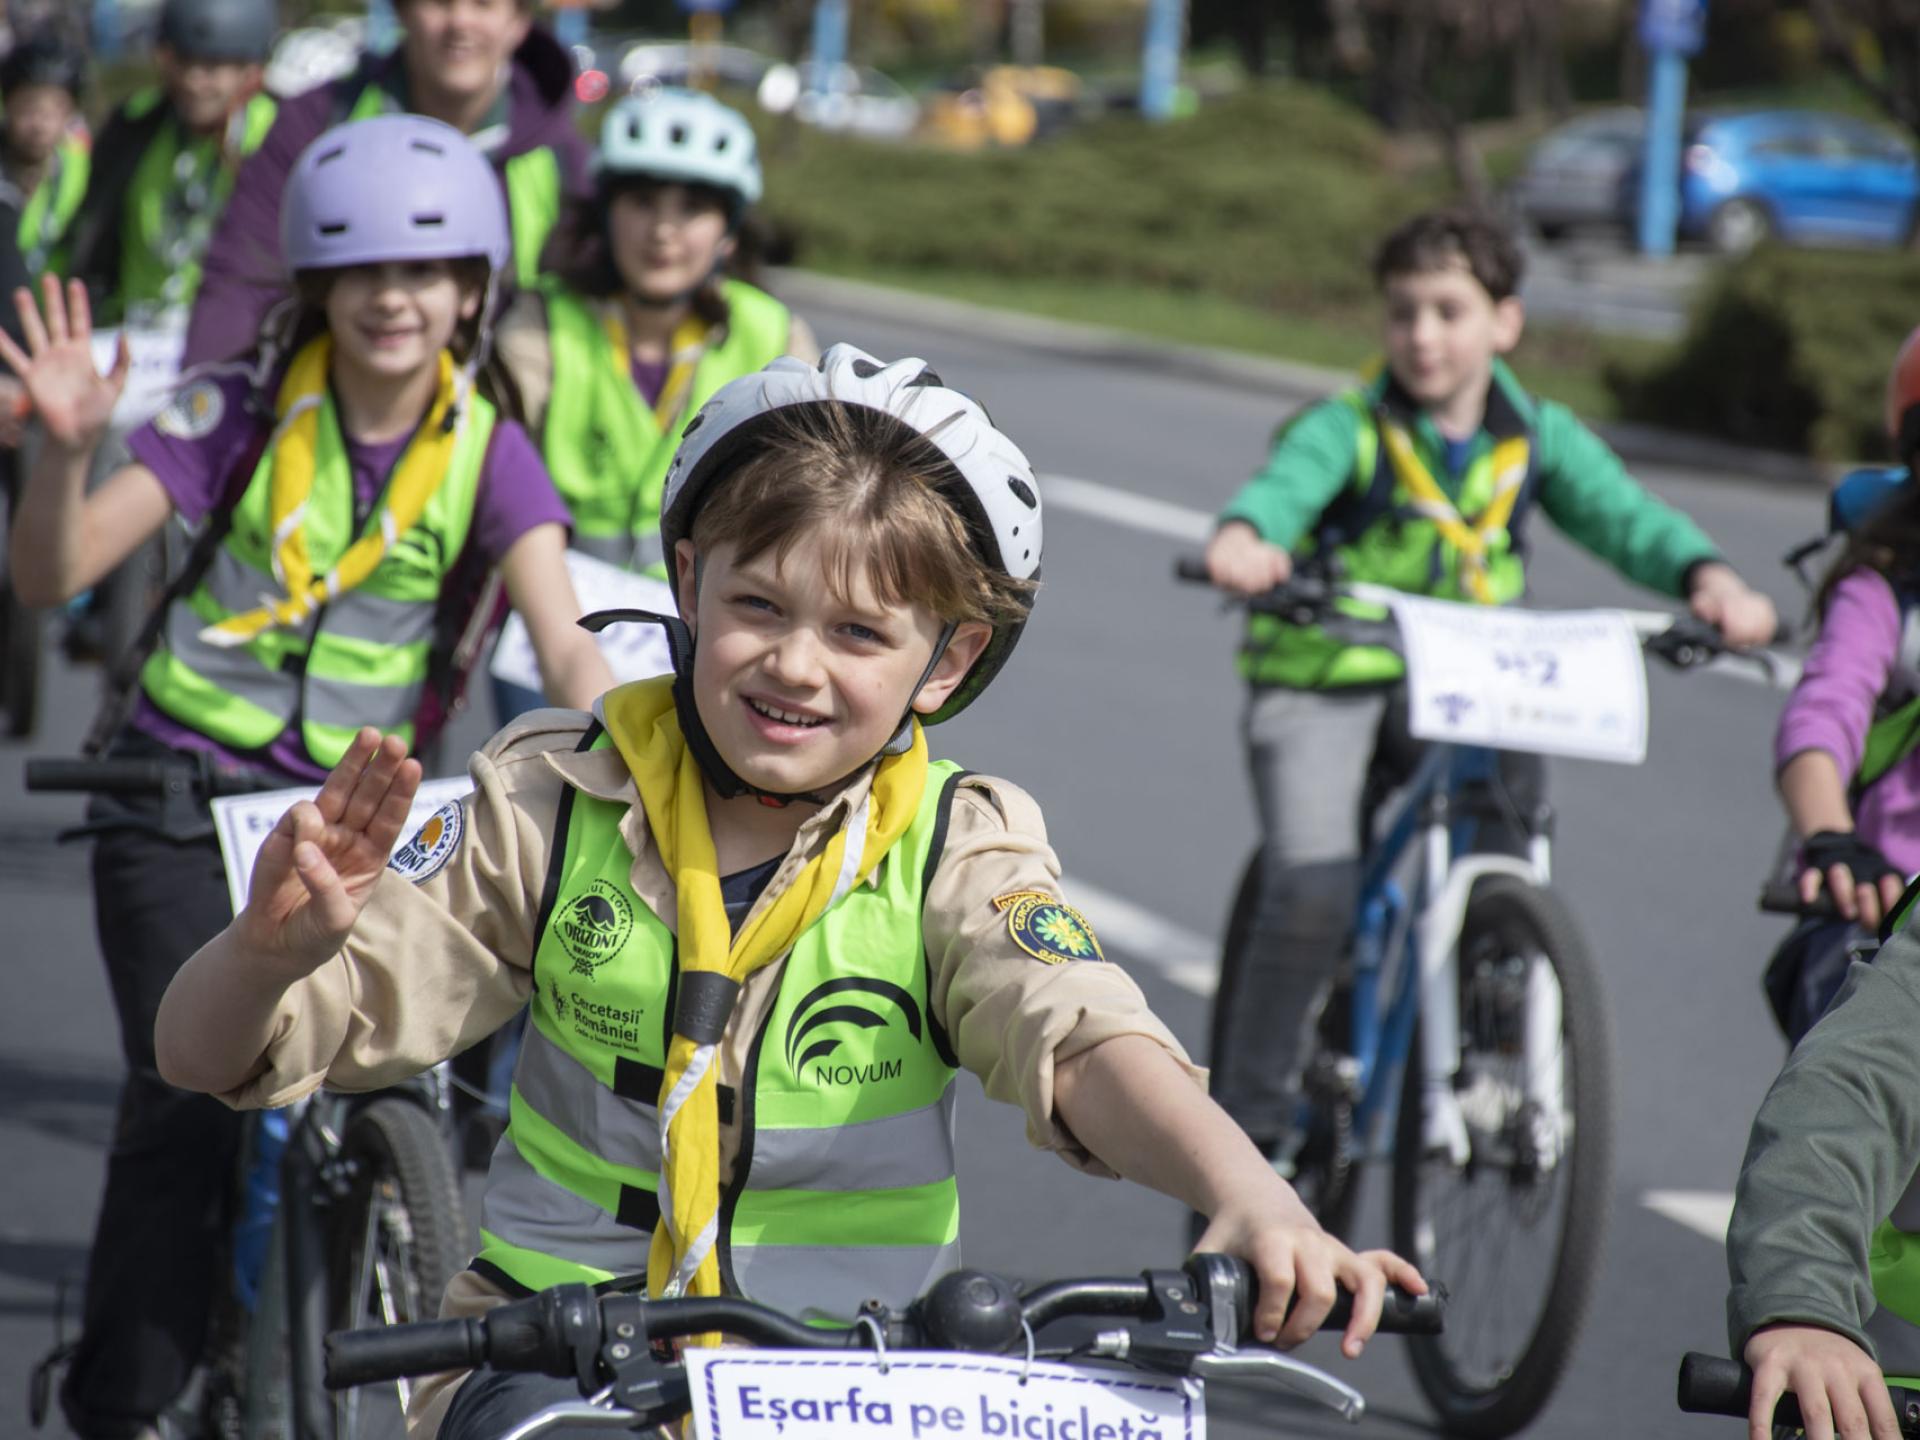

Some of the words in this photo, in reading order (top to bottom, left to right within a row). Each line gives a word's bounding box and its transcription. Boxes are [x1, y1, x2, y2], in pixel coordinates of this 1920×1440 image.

[431, 815, 453, 857] LOCAL
[610, 894, 627, 930] LOCAL
[564, 921, 618, 949] ORIZONT
[574, 1008, 638, 1043] României
[816, 1058, 902, 1086] NOVUM
[738, 1386, 893, 1434] Eșarfa
[910, 1403, 965, 1439] pe
[979, 1394, 1163, 1440] bicicletă
